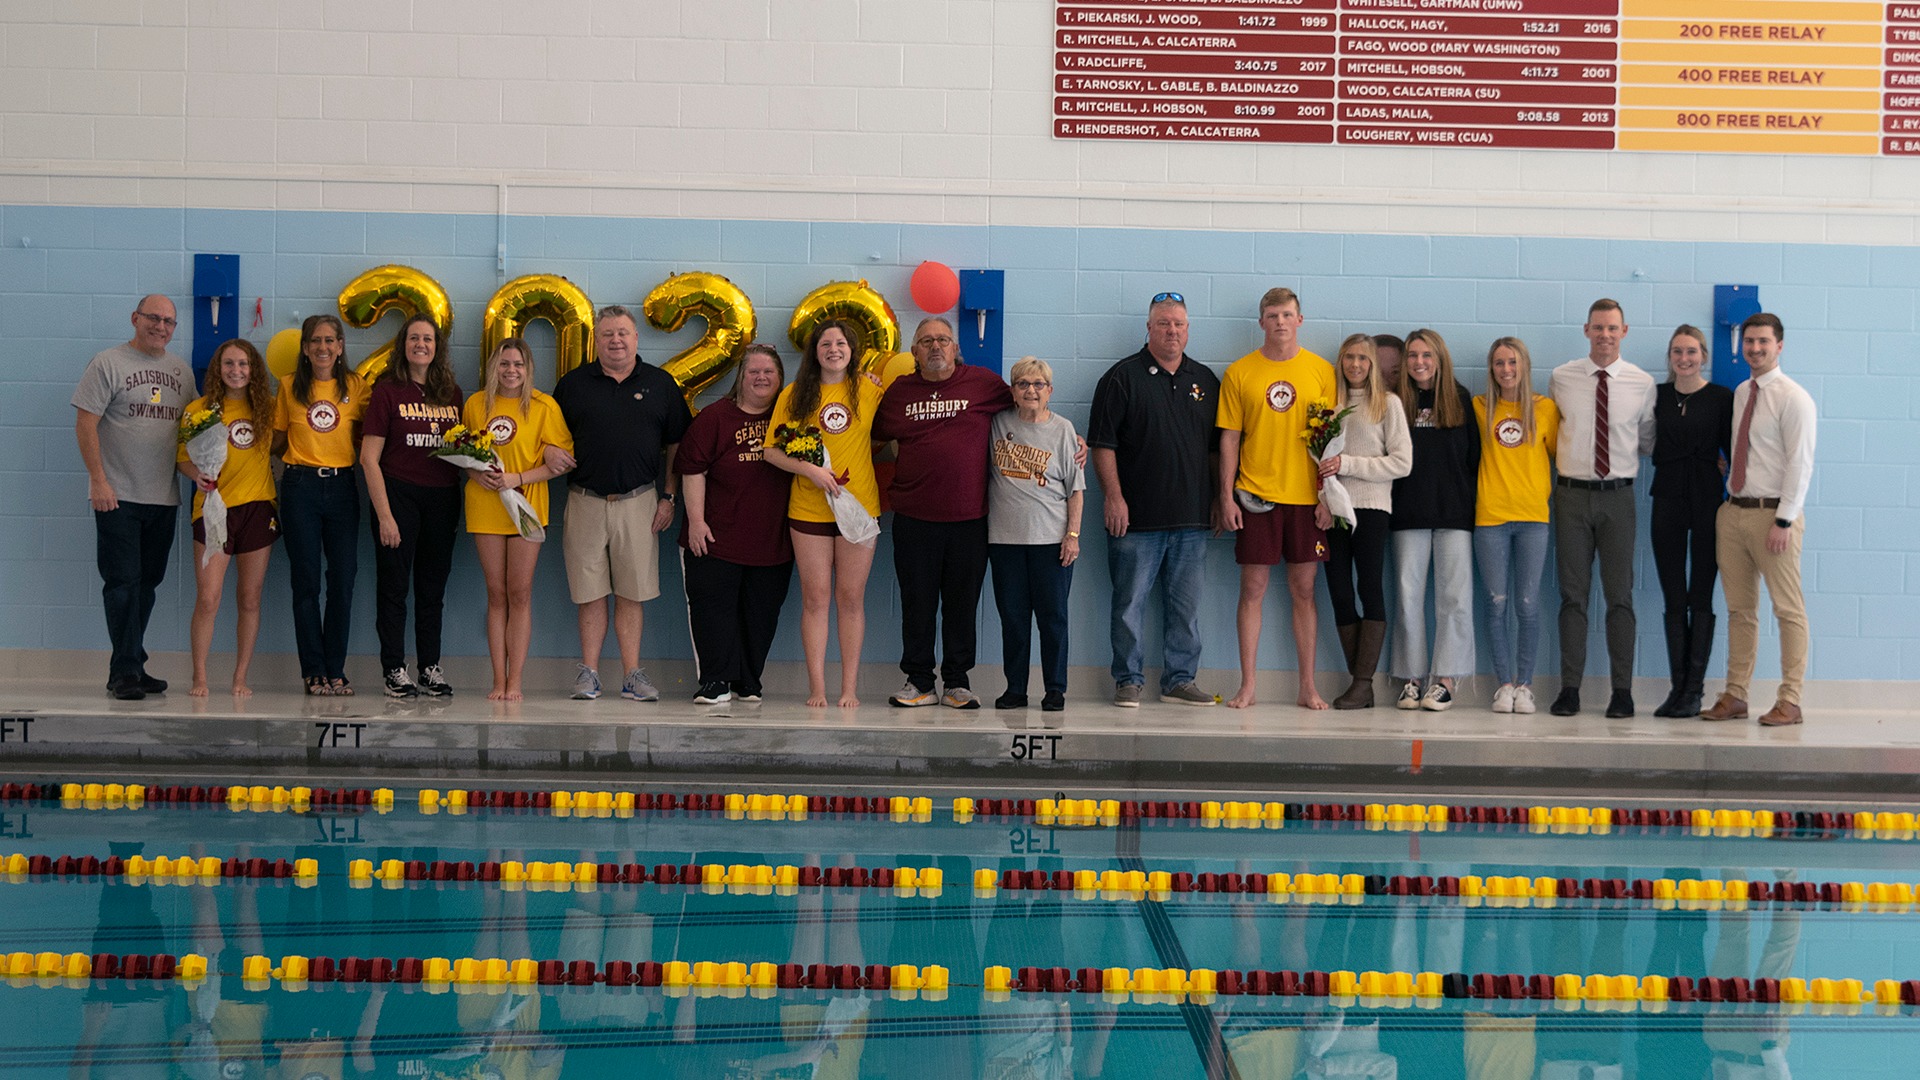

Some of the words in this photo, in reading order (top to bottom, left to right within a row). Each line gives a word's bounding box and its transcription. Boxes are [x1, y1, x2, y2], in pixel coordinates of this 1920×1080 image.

[1348, 0, 1417, 9] WHITESELL,
[1420, 0, 1479, 8] GARTMAN
[1483, 0, 1523, 10] (UMW)
[1064, 12, 1074, 21] T.
[1078, 12, 1142, 24] PIEKARSKI,
[1146, 14, 1155, 23] J.
[1159, 14, 1201, 26] WOOD,
[1239, 16, 1275, 26] 1:41.72
[1301, 17, 1327, 27] 1999
[1349, 19, 1408, 30] HALLOCK,
[1411, 20, 1447, 31] HAGY,
[1523, 22, 1559, 32] 1:52.21
[1584, 23, 1611, 33] 2016
[1680, 25, 1712, 37] 200
[1720, 26, 1762, 38] FREE
[1769, 27, 1824, 39] RELAY
[1064, 34, 1074, 44] R.
[1078, 35, 1139, 47] MITCHELL,
[1142, 36, 1154, 45] A.
[1157, 37, 1236, 47] CALCATERRA
[1348, 41, 1385, 52] FAGO,
[1388, 42, 1428, 52] WOOD
[1431, 43, 1470, 53] (MARY
[1473, 44, 1560, 56] WASHINGTON)
[1063, 57, 1074, 66] V.
[1078, 57, 1146, 69] RADCLIFFE,
[1235, 61, 1277, 70] 3:40.75
[1300, 61, 1326, 71] 2017
[1348, 63, 1408, 75] MITCHELL,
[1412, 65, 1465, 76] HOBSON,
[1521, 67, 1558, 77] 4:11.73
[1582, 68, 1610, 78] 2001
[1679, 69, 1712, 81] 400
[1719, 70, 1760, 82] FREE
[1768, 71, 1823, 83] RELAY
[1063, 79, 1073, 88] E.
[1076, 79, 1144, 92] TARNOSKY,
[1148, 81, 1157, 90] L.
[1161, 81, 1203, 93] GABLE,
[1207, 82, 1217, 91] B.
[1221, 83, 1299, 93] BALDINAZZO
[1347, 86, 1389, 97] WOOD,
[1393, 86, 1472, 97] CALCATERRA
[1475, 88, 1500, 99] (SU)
[1062, 101, 1072, 111] R.
[1077, 102, 1137, 114] MITCHELL,
[1140, 103, 1149, 112] J.
[1153, 104, 1206, 115] HOBSON,
[1235, 105, 1275, 115] 8:10.99
[1298, 106, 1325, 116] 2001
[1347, 108, 1389, 119] LADAS,
[1393, 109, 1432, 120] MALIA,
[1517, 111, 1560, 121] 9:08.58
[1582, 112, 1608, 122] 2013
[1677, 114, 1710, 126] 800
[1717, 114, 1759, 127] FREE
[1766, 115, 1821, 128] RELAY
[1890, 118, 1900, 129] J.
[1903, 119, 1920, 129] RY
[1062, 124, 1072, 133] R.
[1076, 124, 1159, 136] HENDERSHOT,
[1166, 126, 1177, 135] A.
[1181, 126, 1260, 137] CALCATERRA
[1346, 130, 1413, 142] LOUGHERY,
[1417, 132, 1455, 141] WISER
[1458, 132, 1493, 143] (CUA)
[126, 370, 182, 396] SALISBURY
[905, 400, 969, 416] SALISBURY
[406, 433, 450, 448] SWIMM
[735, 424, 768, 445] SEAGU
[738, 452, 764, 462] SWIM
[994, 439, 1052, 465] SALISBURY
[315, 723, 366, 748] 7FT
[1011, 735, 1062, 760] 5FT
